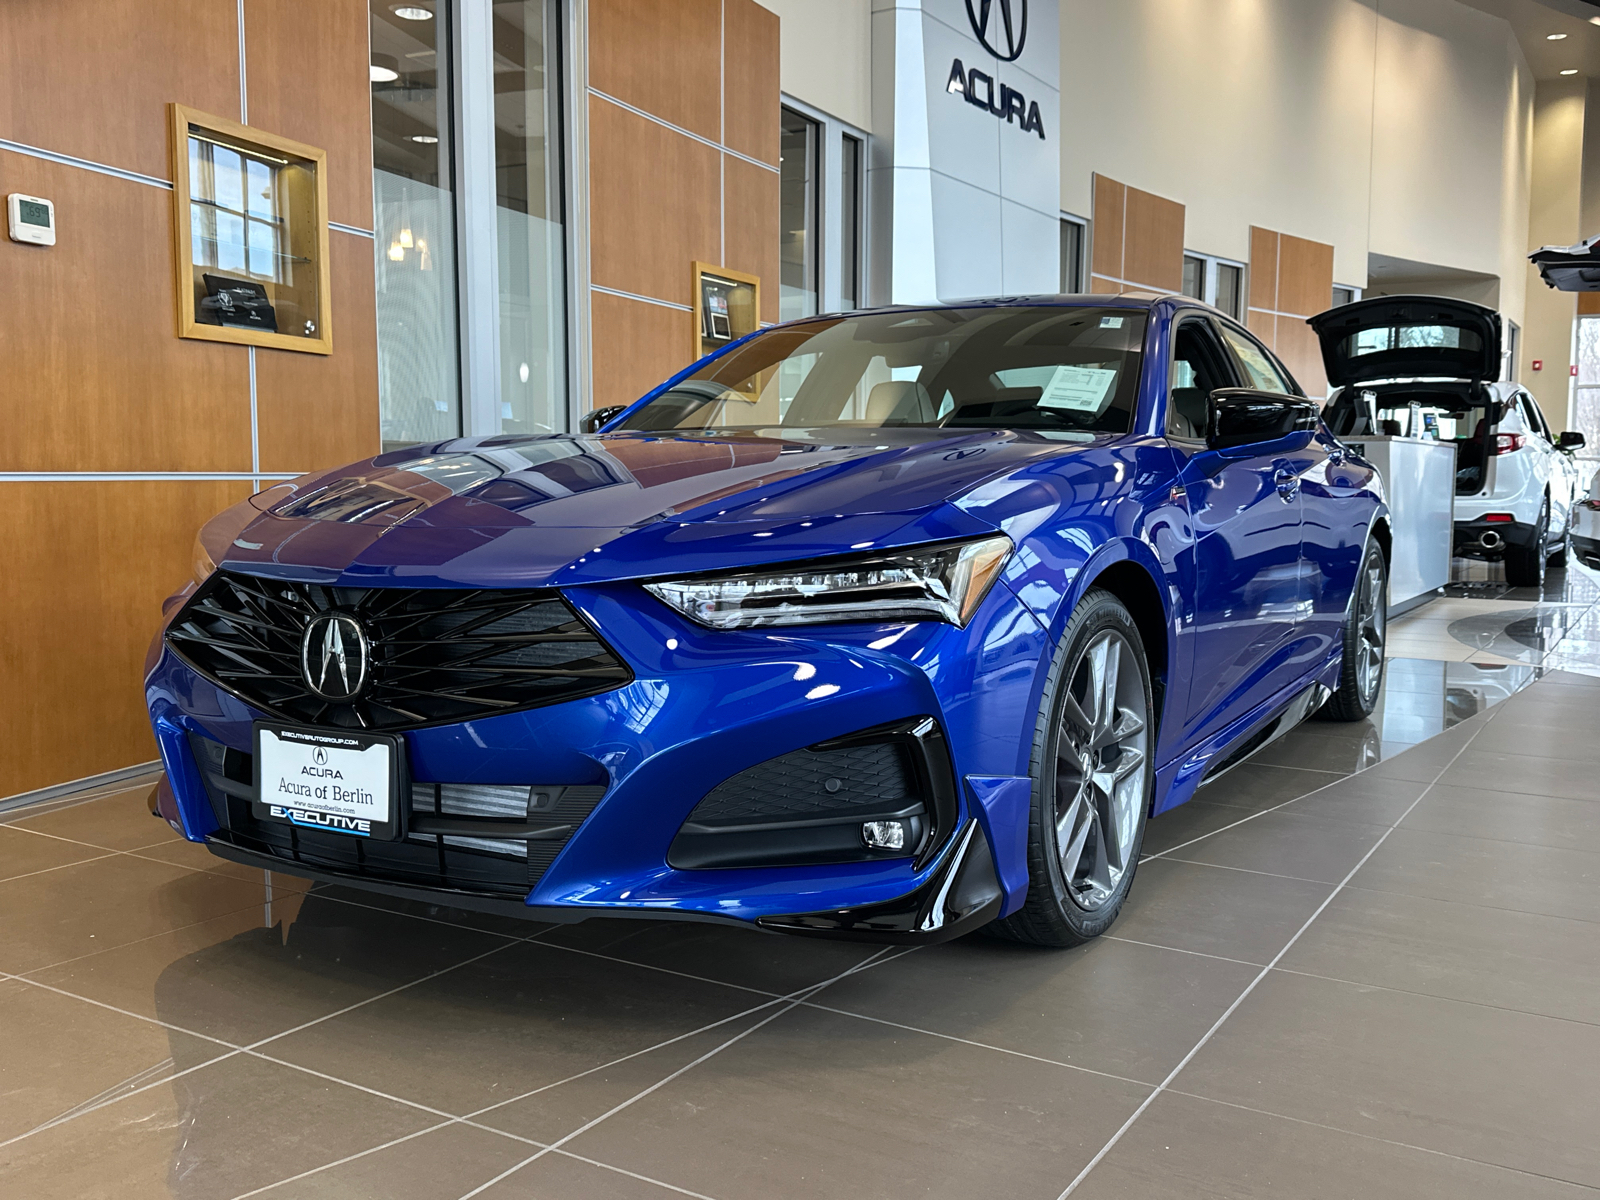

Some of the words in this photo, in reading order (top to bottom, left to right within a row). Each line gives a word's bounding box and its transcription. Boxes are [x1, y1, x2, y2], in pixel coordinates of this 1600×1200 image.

[946, 58, 1046, 140] ACURA
[281, 730, 358, 746] EXECUTIVEAUTOGROUP.COM
[301, 766, 344, 780] ACURA
[278, 777, 312, 798] Acura
[314, 785, 328, 800] of
[332, 785, 374, 805] Berlin
[293, 800, 356, 814] www.acuraofberlin.com
[270, 805, 371, 832] EXECUTIVE
